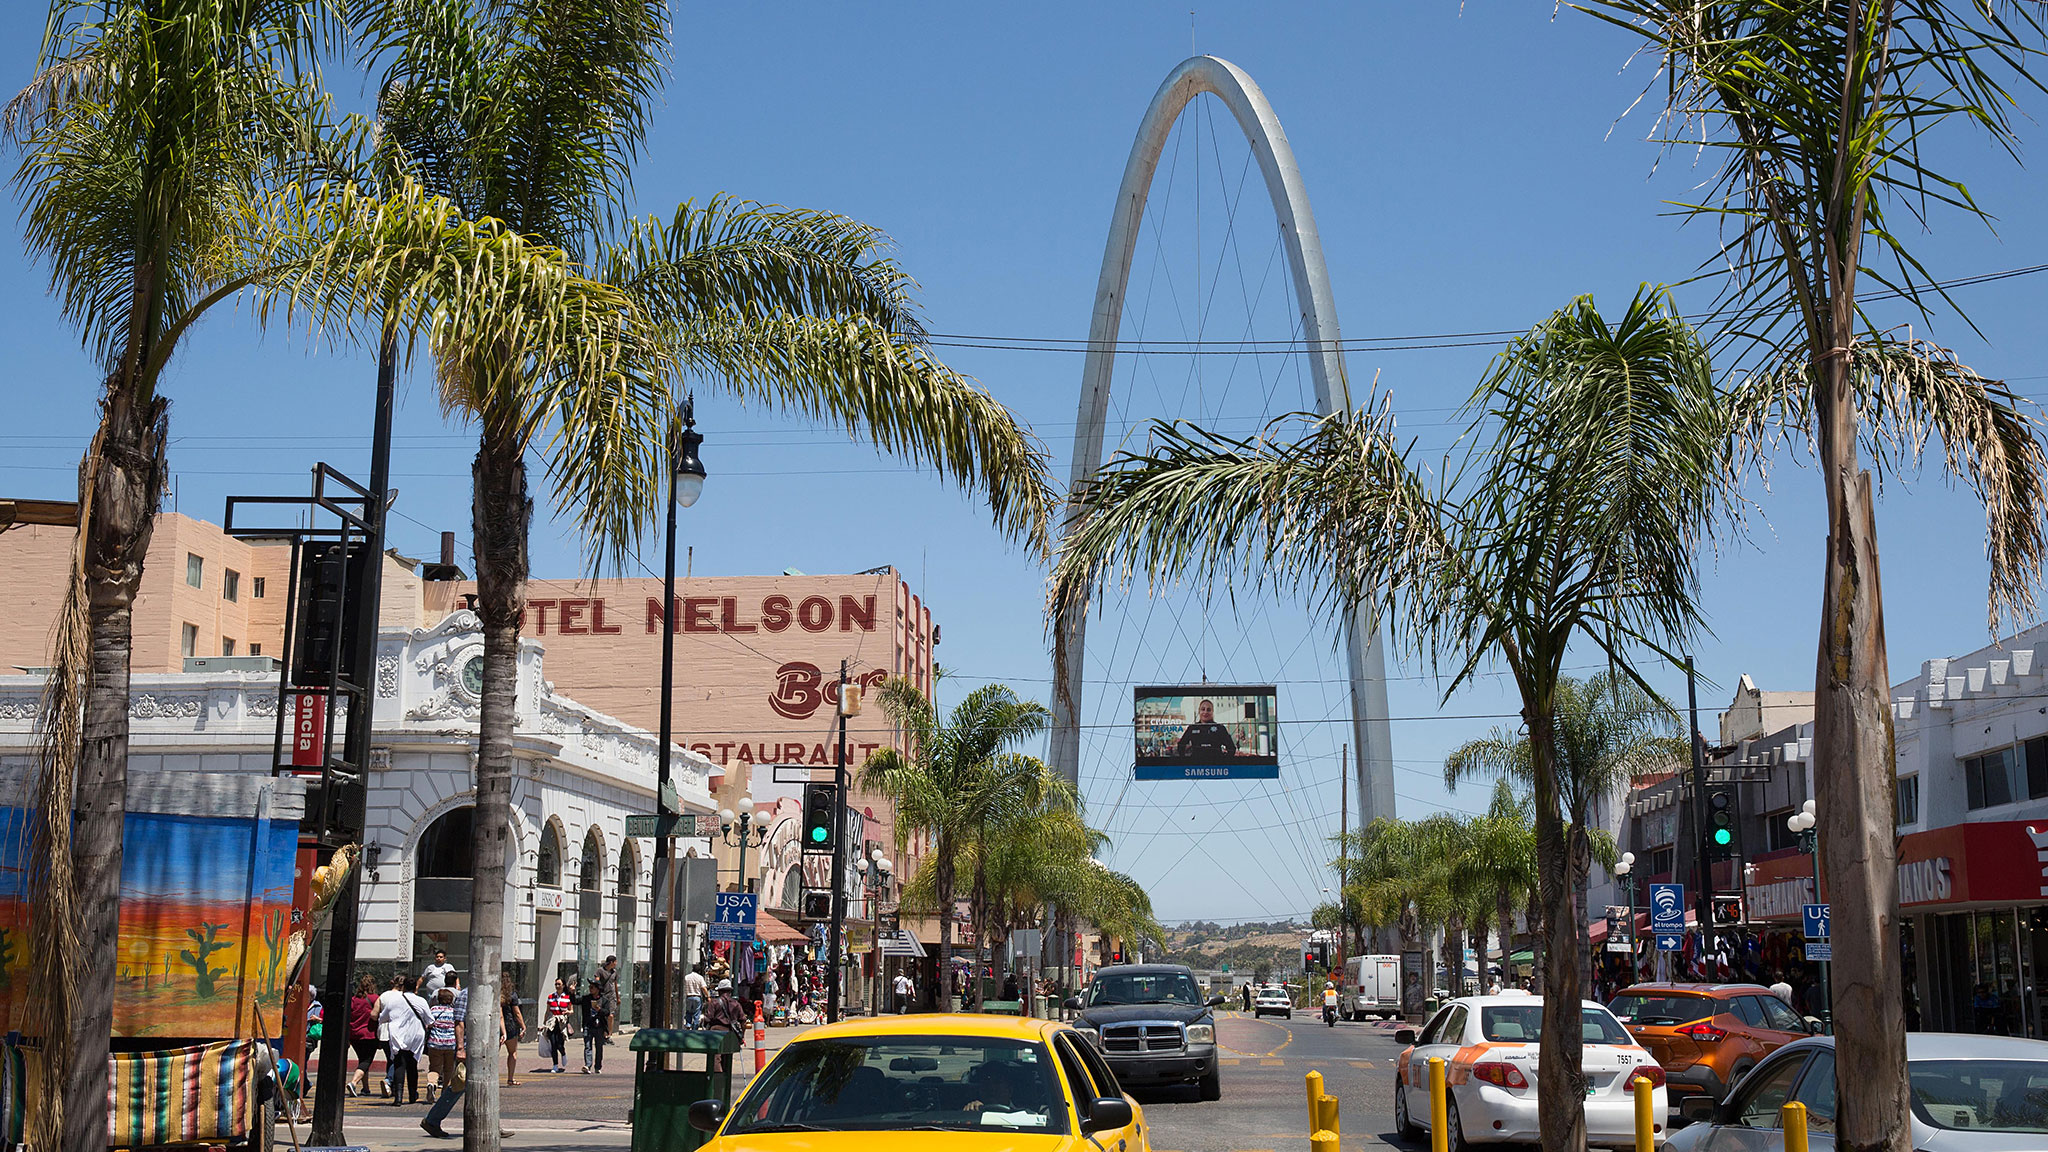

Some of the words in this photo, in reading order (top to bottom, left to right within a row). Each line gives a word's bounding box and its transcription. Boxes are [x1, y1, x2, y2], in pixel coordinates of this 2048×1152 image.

[519, 597, 622, 636] TEL
[645, 594, 877, 635] NELSON
[768, 661, 889, 720] Bar
[299, 694, 315, 751] encia
[1150, 718, 1182, 726] CIUDAD
[1150, 725, 1184, 733] SEGURA
[678, 743, 880, 765] STAURANT
[1184, 768, 1229, 776] SAMSUNG
[628, 818, 655, 836] BENITO
[1897, 857, 1952, 904] ANOS
[716, 895, 752, 908] USA
[1726, 903, 1739, 918] 46
[1808, 907, 1830, 920] US
[1661, 921, 1684, 930] trompo
[1617, 1054, 1632, 1065] 7557
